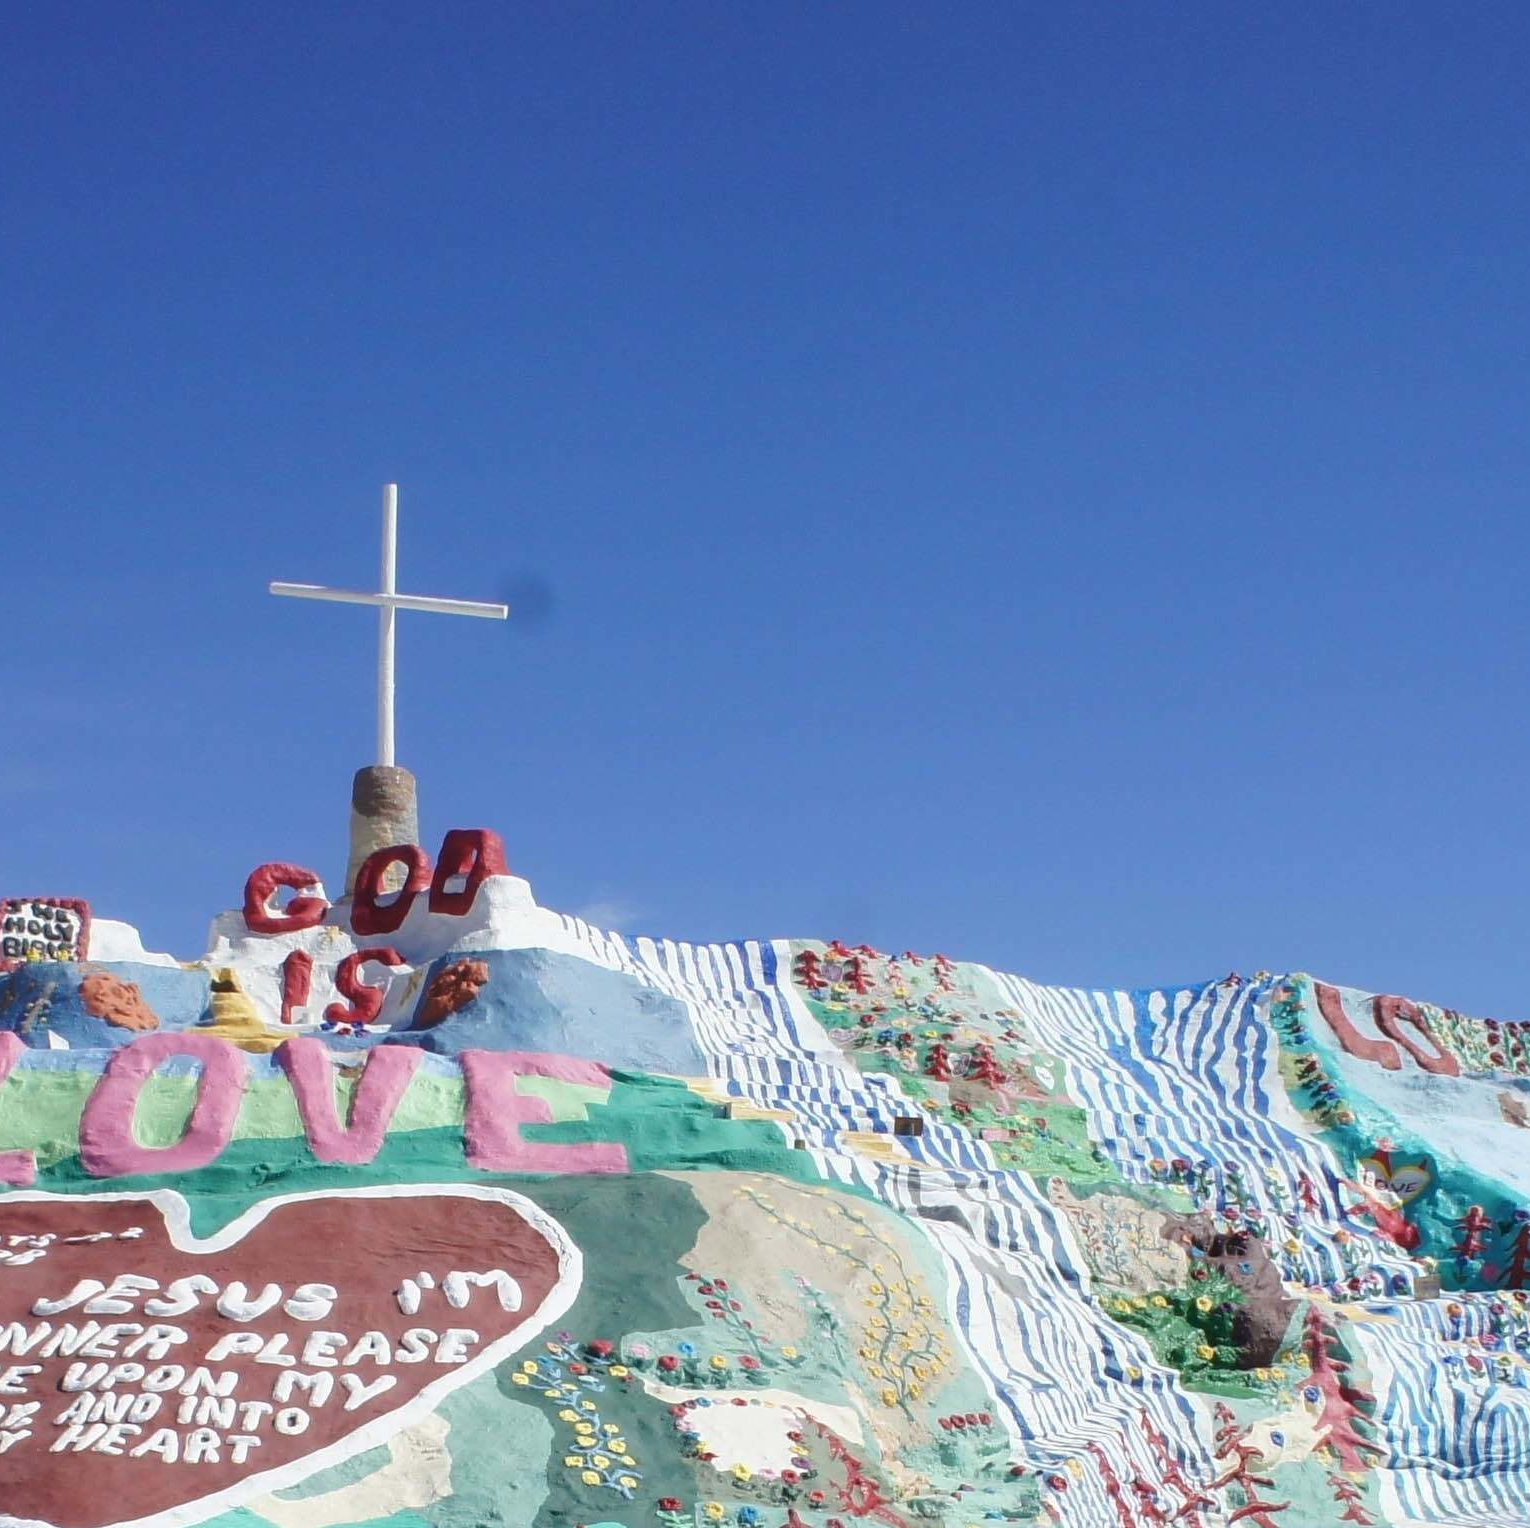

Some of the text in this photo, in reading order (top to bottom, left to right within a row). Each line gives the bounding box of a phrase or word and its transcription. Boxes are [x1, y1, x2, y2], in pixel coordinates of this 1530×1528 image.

[243, 829, 509, 935] GOD
[4, 917, 74, 942] HOLY
[280, 946, 407, 1025] IS
[31, 1273, 338, 1322] JESUS
[398, 1269, 523, 1315] I'M
[204, 1328, 480, 1366] PLEASE
[60, 1362, 239, 1397] UPON
[272, 1370, 398, 1411] MY
[53, 1391, 163, 1425] AND
[176, 1395, 311, 1436] INTO
[49, 1422, 262, 1464] HEART
